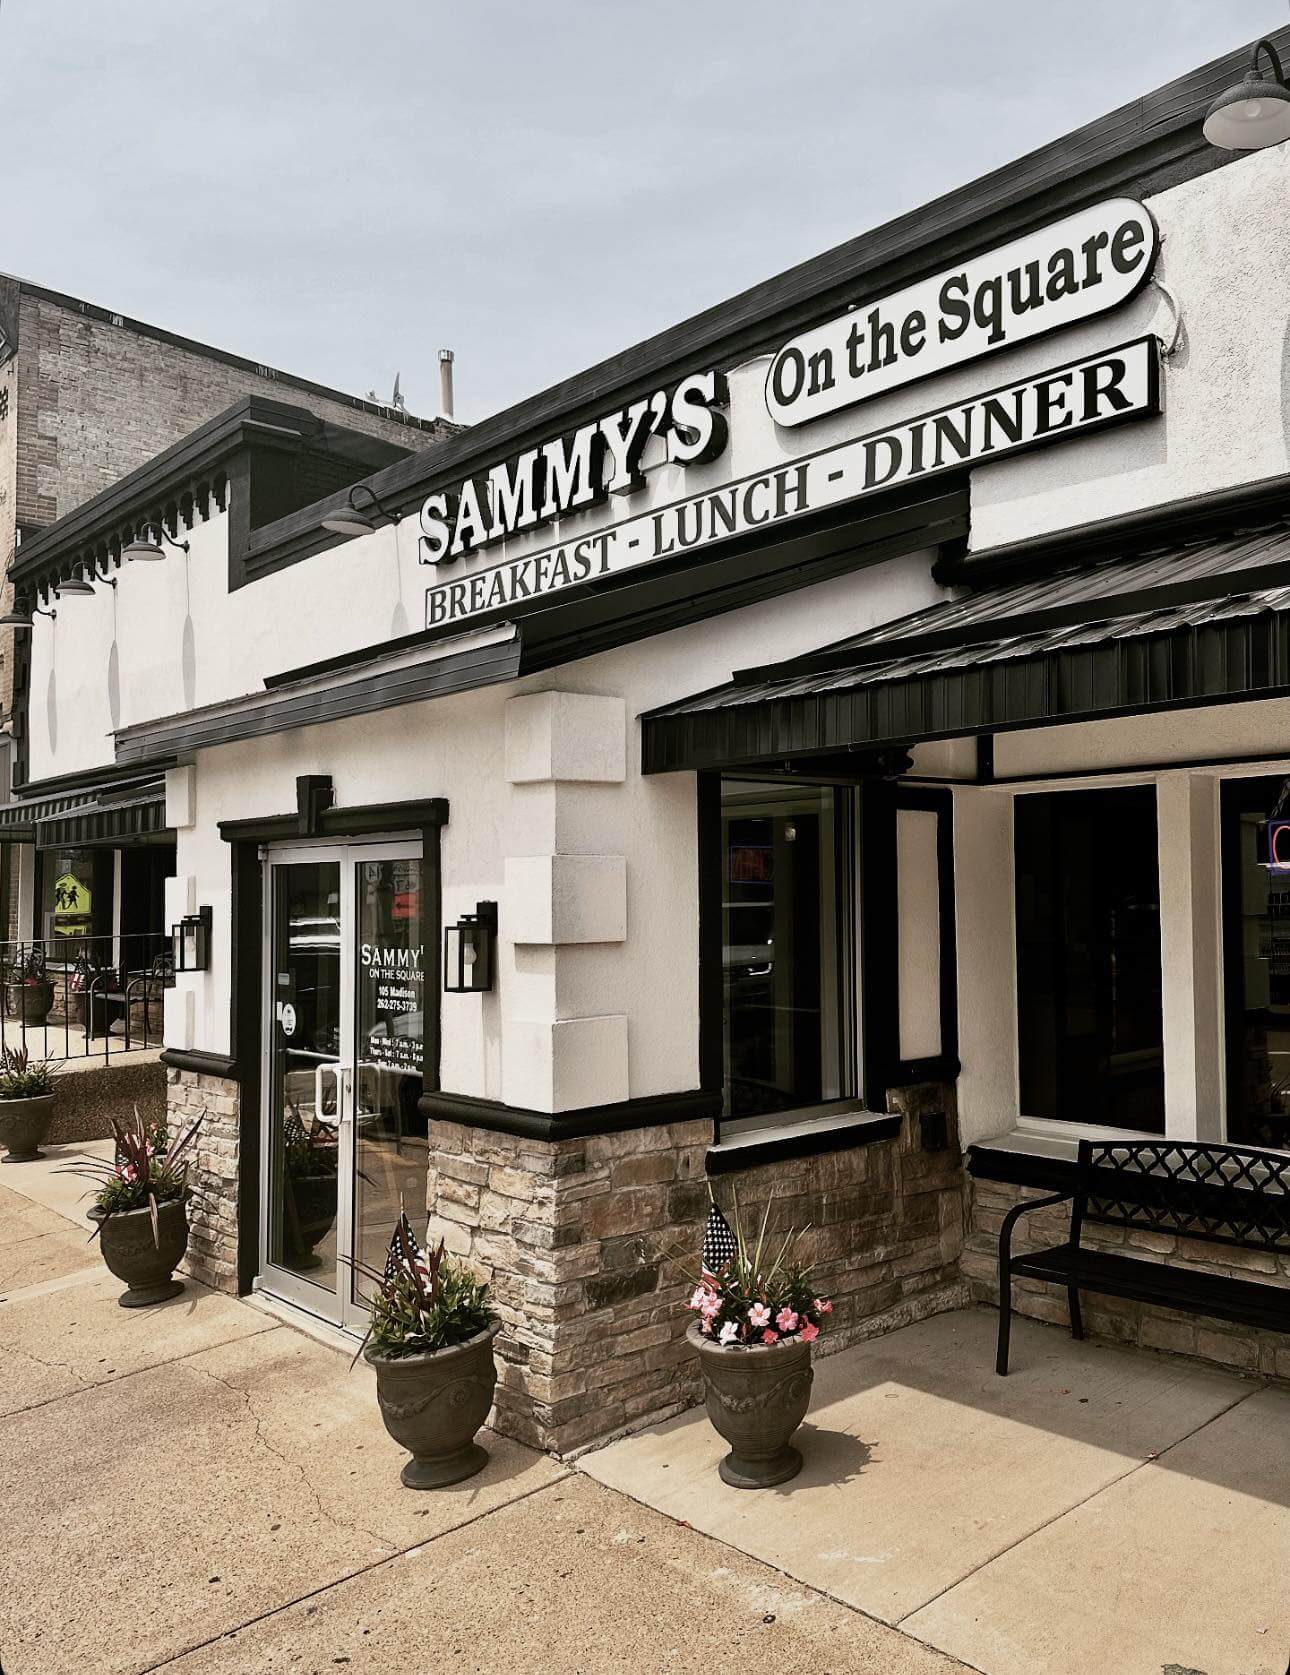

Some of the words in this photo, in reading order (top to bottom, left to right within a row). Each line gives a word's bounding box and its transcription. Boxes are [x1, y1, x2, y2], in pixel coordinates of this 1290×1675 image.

[772, 347, 836, 407] On
[845, 307, 927, 380] the
[937, 219, 1146, 346] Square
[418, 371, 720, 566] SAMMY'S
[428, 531, 617, 626] BREAKFAST
[651, 463, 810, 558] LUNCH
[861, 357, 1134, 491] DINNER
[361, 943, 425, 968] SAMMY'
[369, 967, 380, 979] ON
[380, 968, 395, 980] THE
[396, 969, 425, 982] SQUARE
[378, 985, 389, 997] 105
[390, 986, 416, 998] Madison
